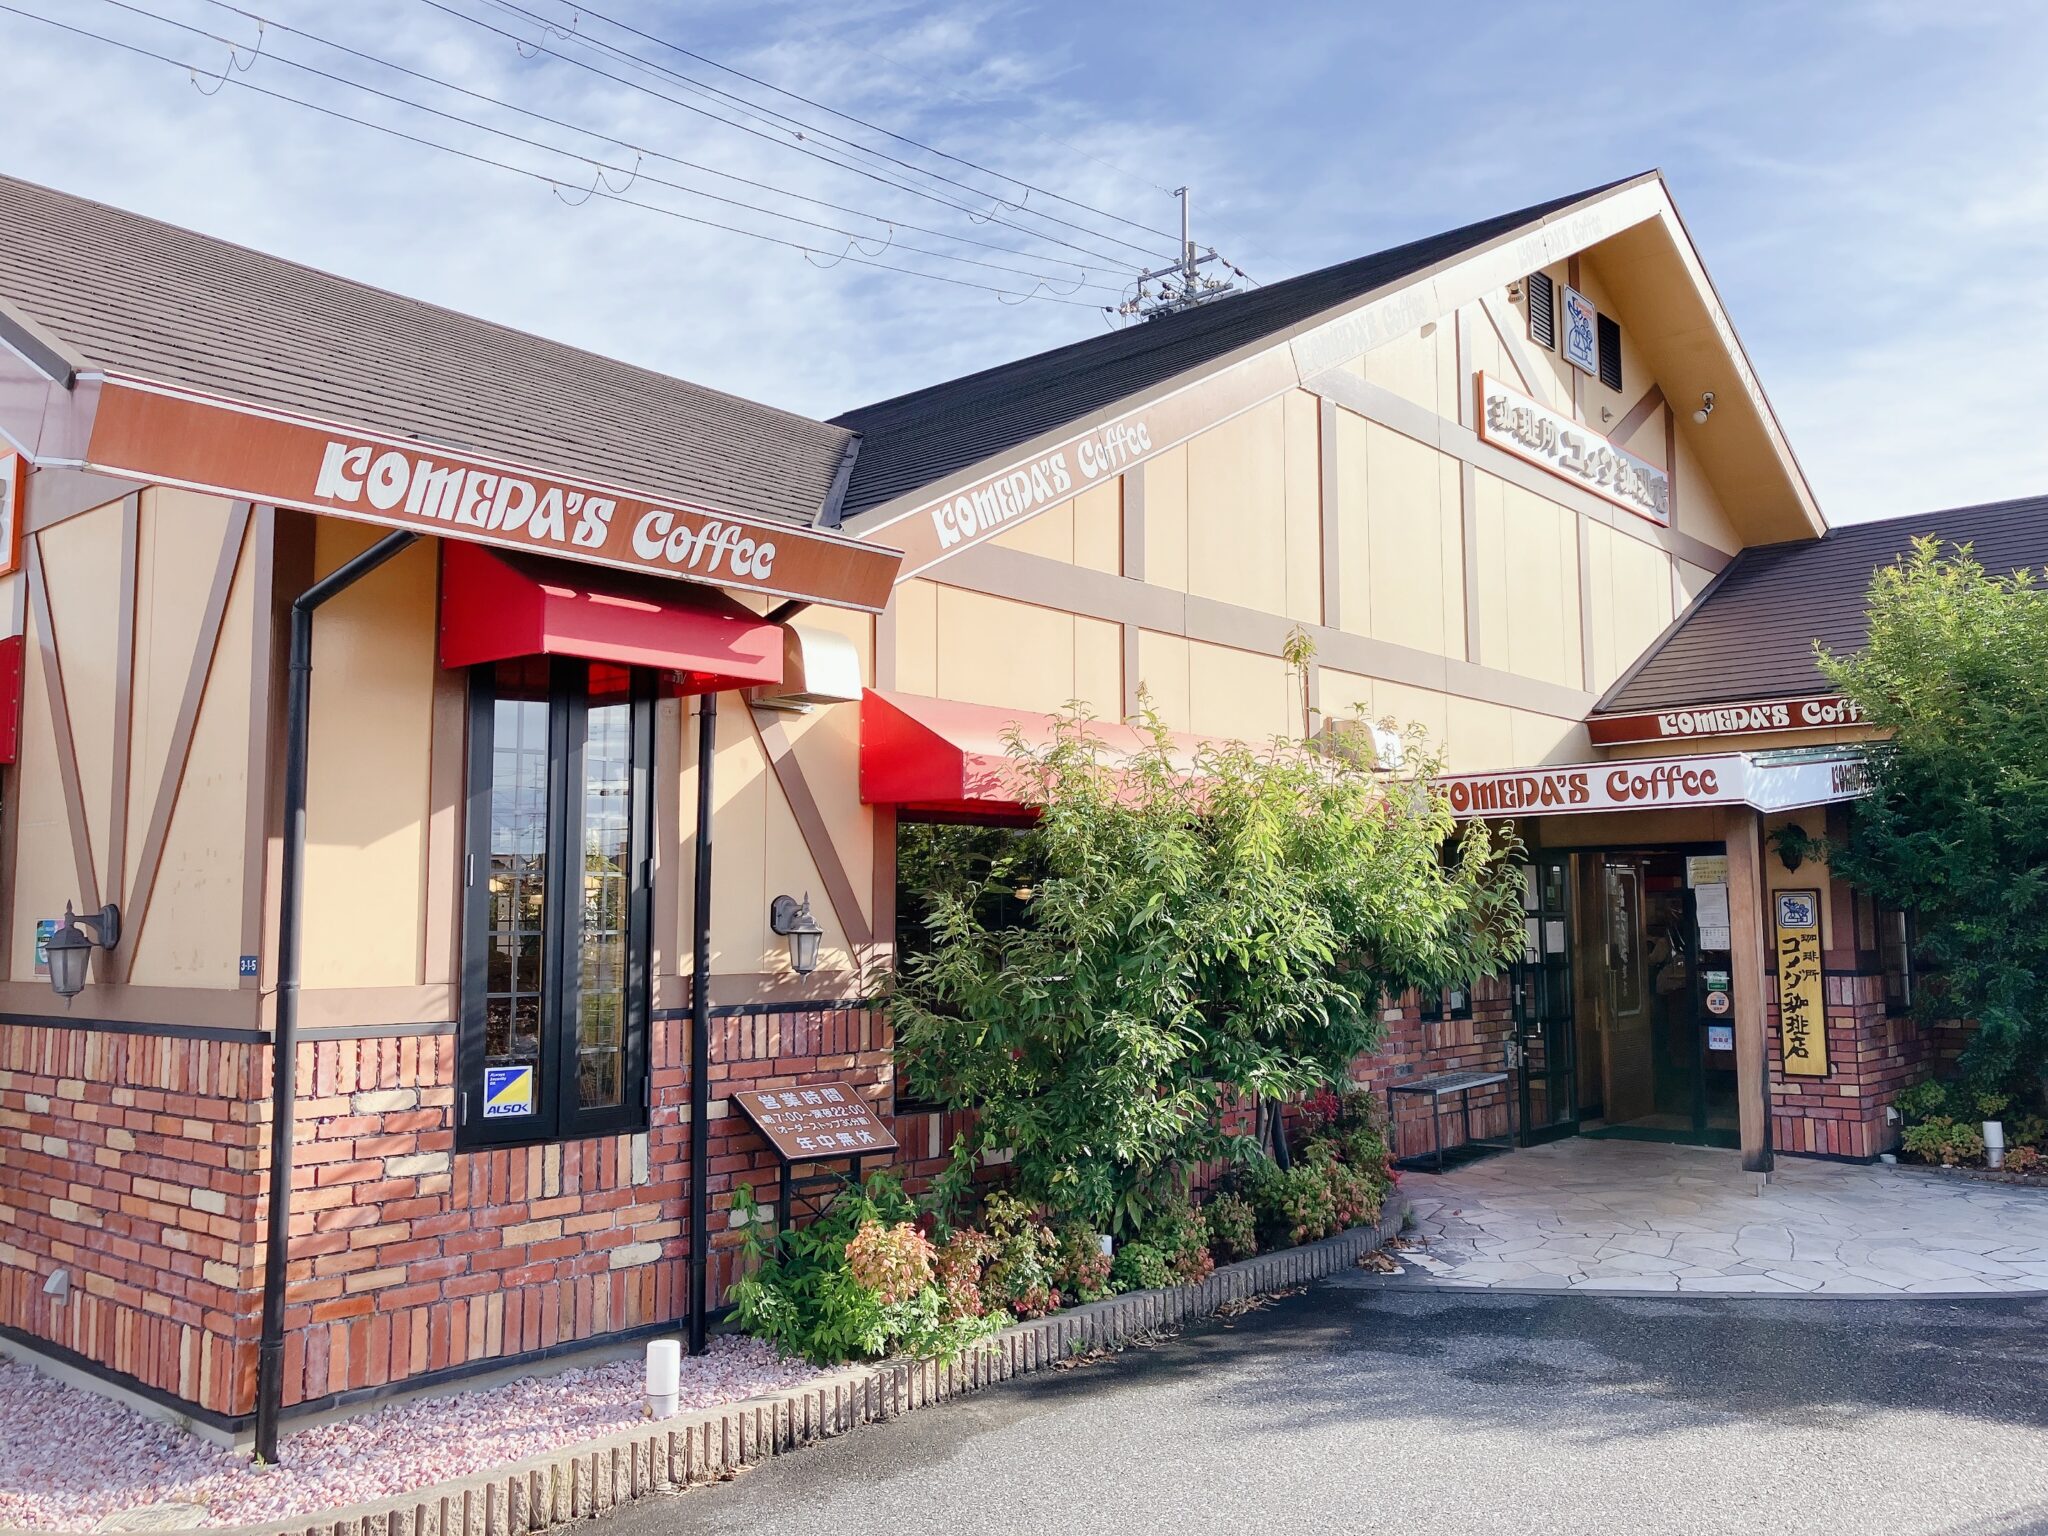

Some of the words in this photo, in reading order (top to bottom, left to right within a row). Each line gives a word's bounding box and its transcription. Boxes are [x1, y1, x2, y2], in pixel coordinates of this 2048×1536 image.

[931, 452, 1072, 549] KOMEDA'S
[1077, 421, 1152, 479] Coffee
[313, 441, 617, 549] KOMEDA'S
[632, 510, 777, 580] Coffee
[1658, 704, 1790, 736] KOMEDA'S
[1801, 698, 1864, 725] Coff
[1606, 765, 1719, 802] Coffee
[241, 960, 256, 971] 3-1-5
[1800, 933, 1820, 982] 珈琲所
[1782, 936, 1811, 1060] コメダ珈琲店
[487, 1103, 528, 1114] ALSOK
[758, 1088, 844, 1110] 営業時間
[796, 1130, 876, 1151] 年中無休
